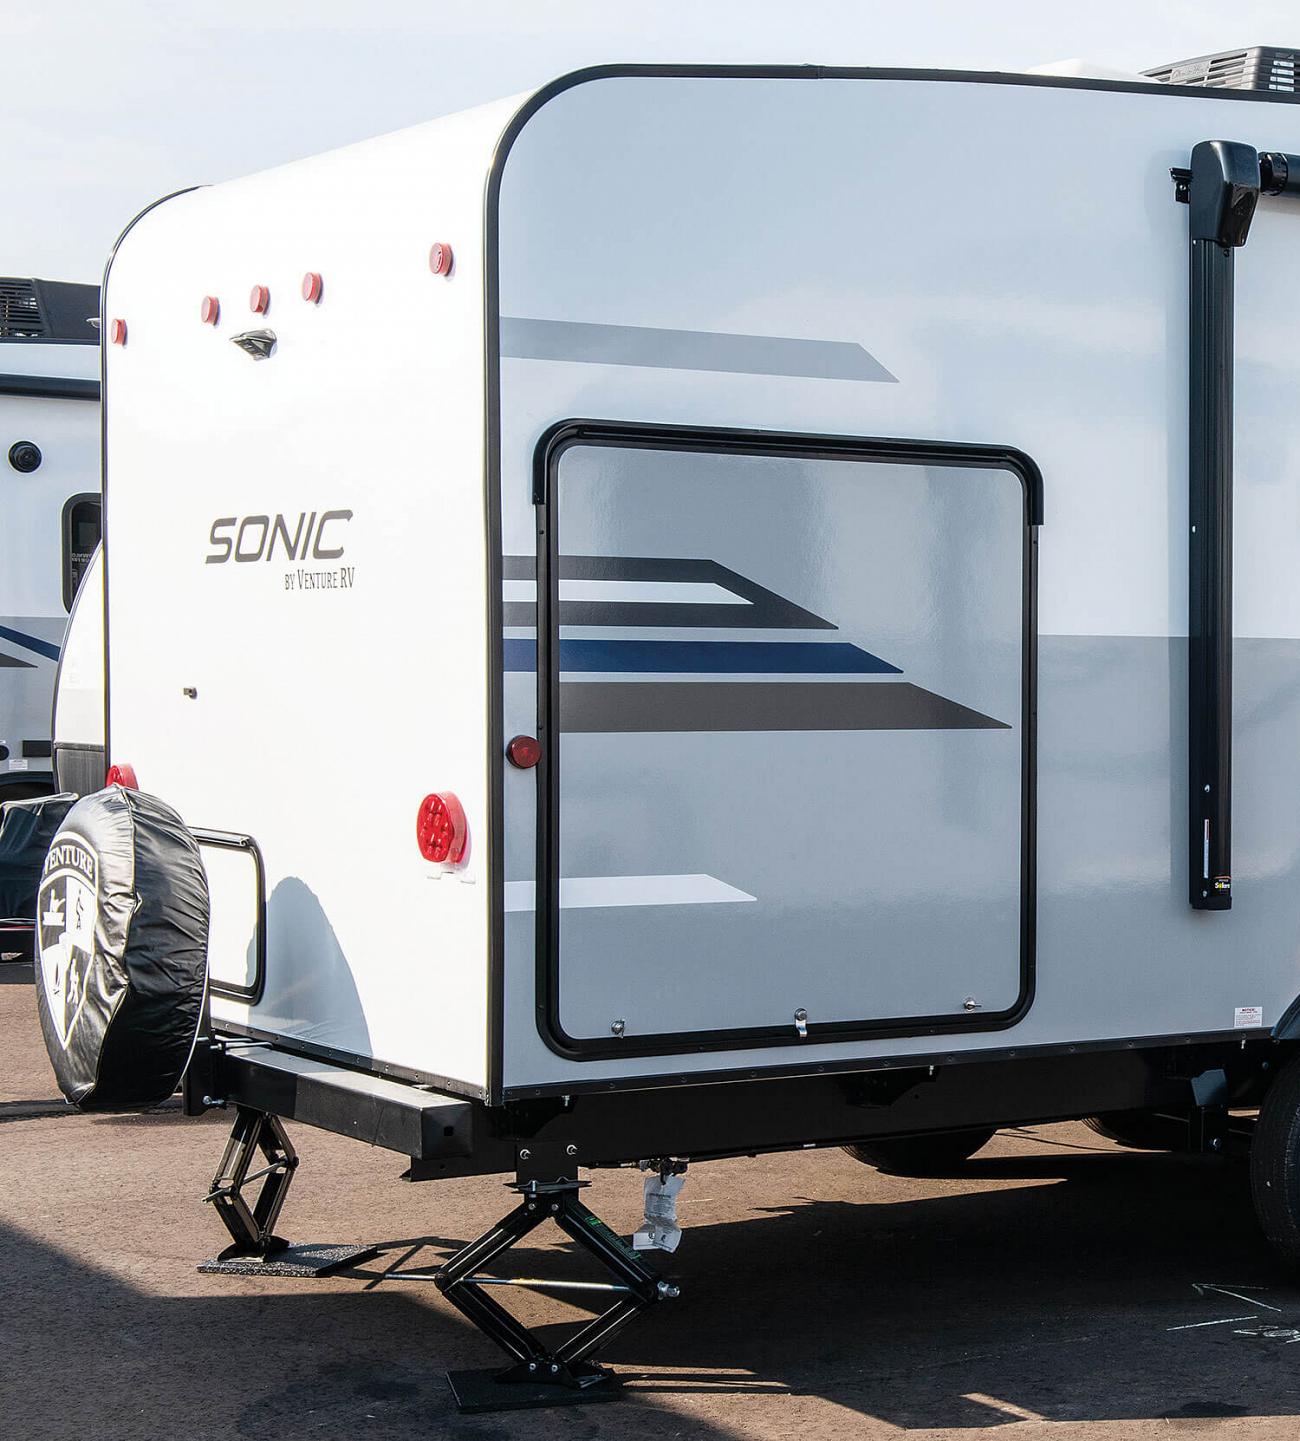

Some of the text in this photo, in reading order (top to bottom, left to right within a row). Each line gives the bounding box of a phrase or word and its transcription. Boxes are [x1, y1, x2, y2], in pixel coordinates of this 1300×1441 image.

[205, 509, 354, 564] SONIC
[285, 566, 355, 590] BY VENTURE RV
